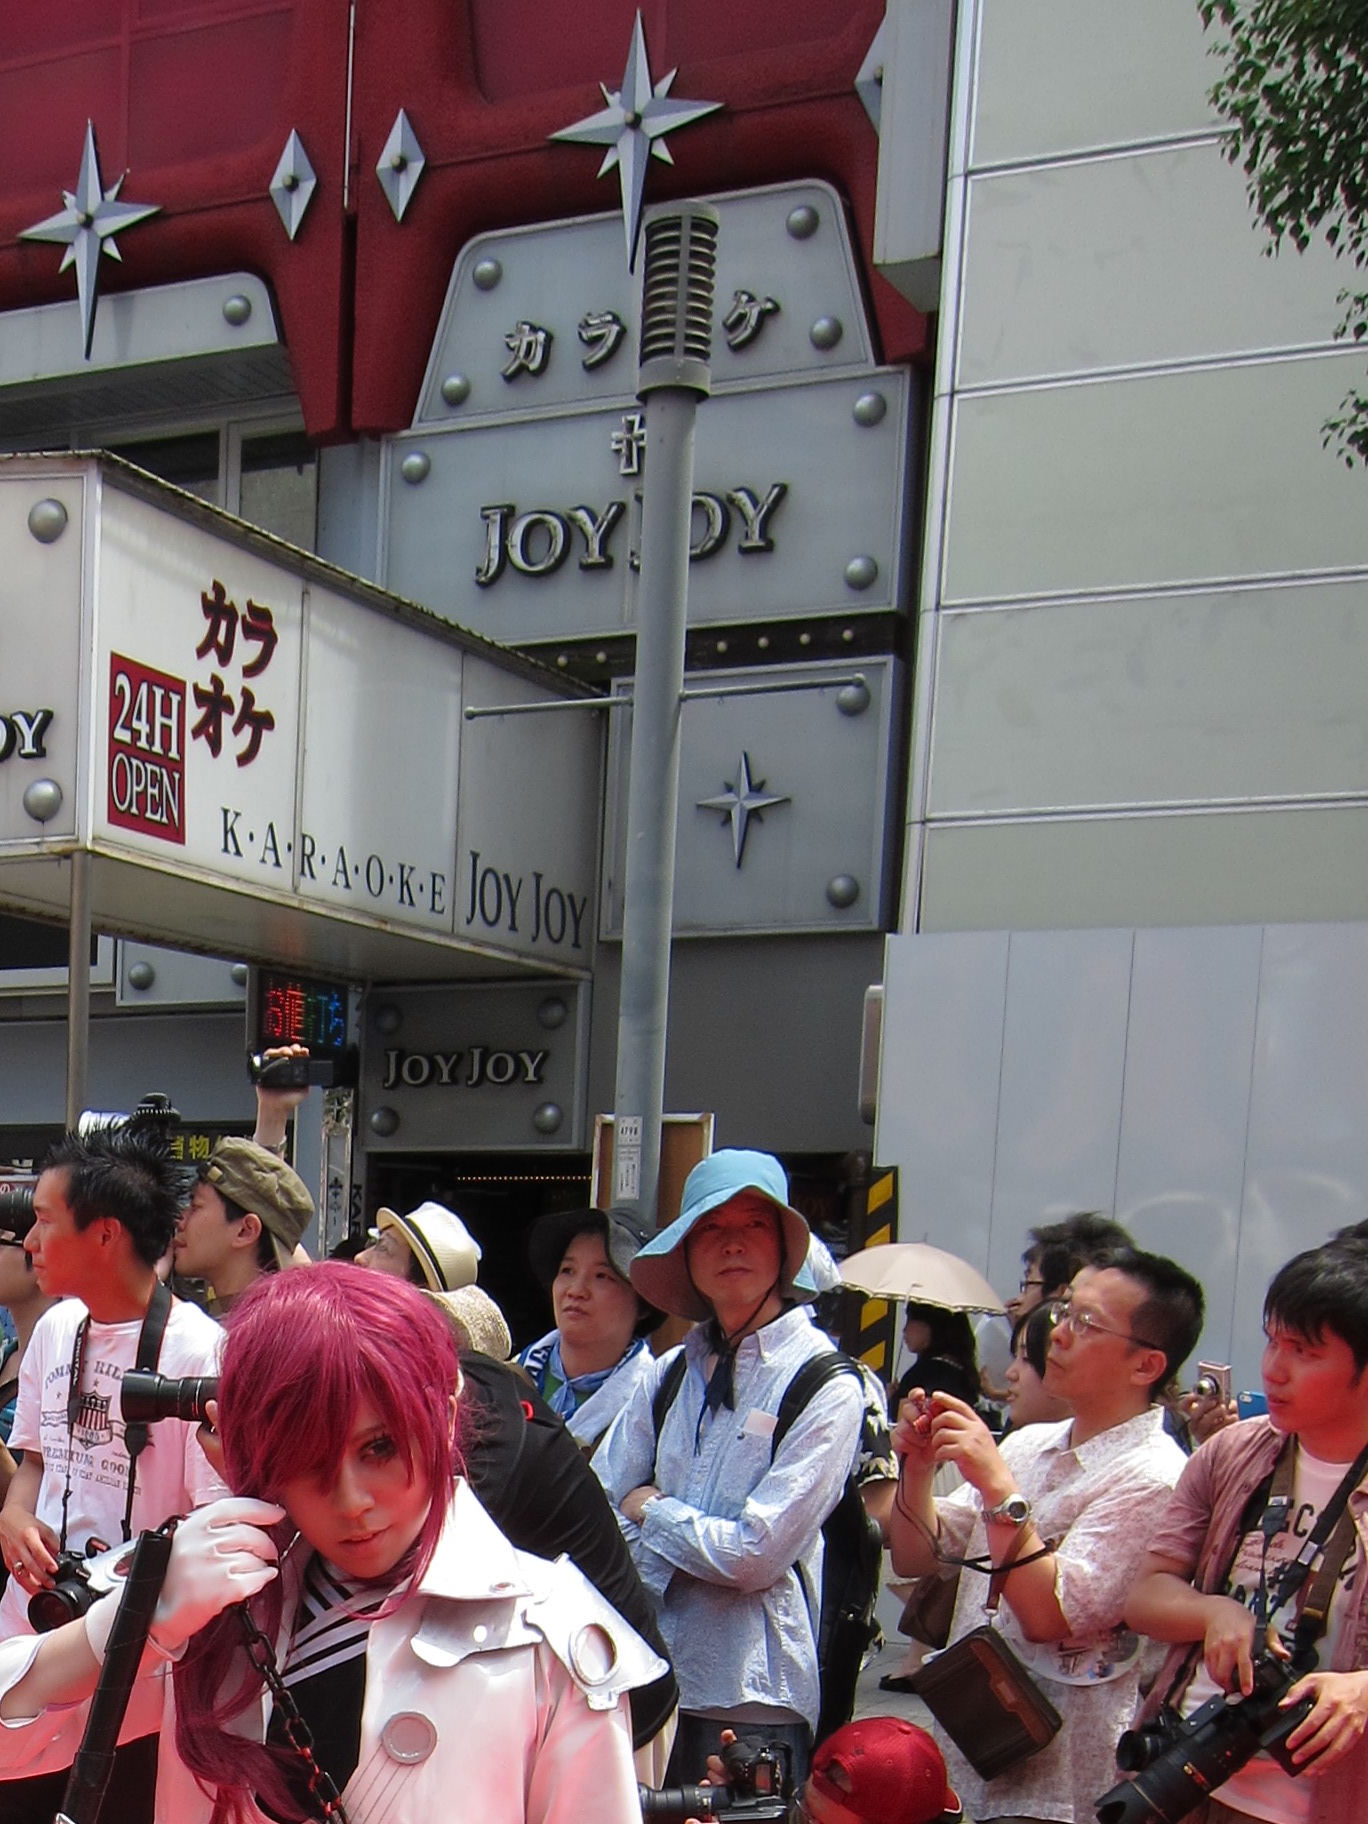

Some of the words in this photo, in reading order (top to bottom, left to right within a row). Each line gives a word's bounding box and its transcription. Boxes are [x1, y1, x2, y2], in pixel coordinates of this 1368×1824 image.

[501, 290, 781, 381] カラケ
[475, 500, 626, 588] JOY
[195, 579, 279, 678] カラ
[112, 674, 183, 763] 24H
[191, 674, 275, 767] オケ
[112, 752, 183, 828] OPEN
[466, 850, 522, 933] JOY
[532, 871, 588, 949] JOY
[384, 1051, 460, 1089] JOY
[467, 1047, 549, 1086] JOY
